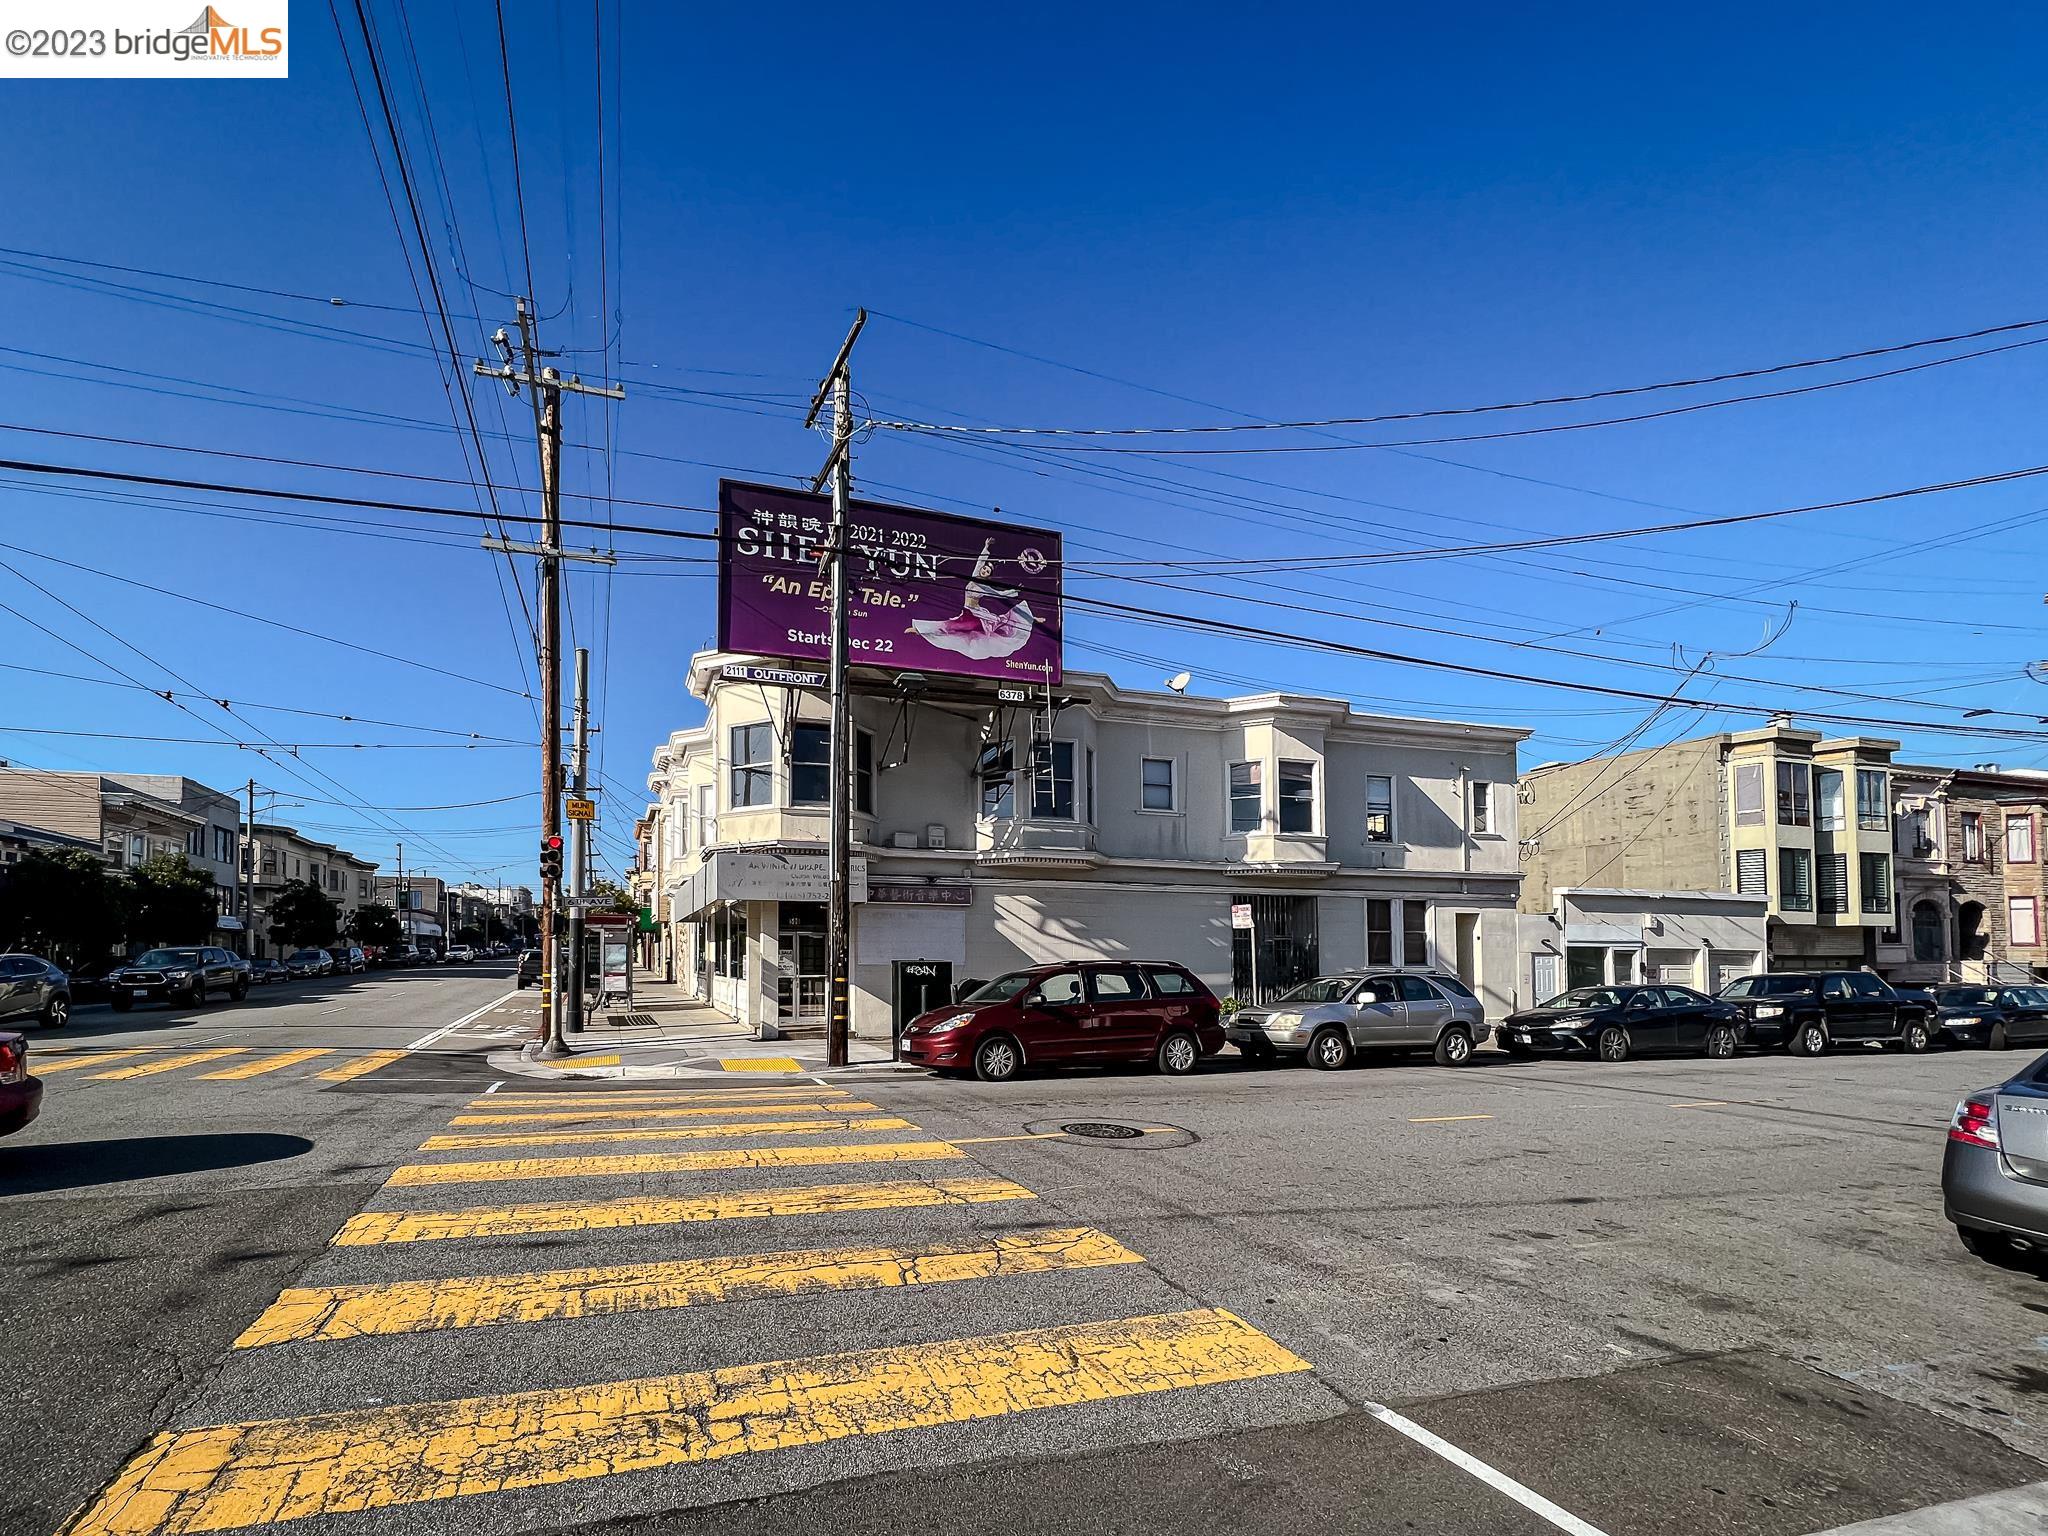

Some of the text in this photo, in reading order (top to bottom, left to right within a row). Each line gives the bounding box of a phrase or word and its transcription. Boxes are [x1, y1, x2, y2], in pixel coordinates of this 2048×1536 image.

[752, 508, 834, 534] 神韻晚
[850, 524, 927, 549] 2021-2022
[737, 527, 937, 580] SHE YUN
[808, 581, 853, 602] Ep
[874, 639, 893, 652] 22
[726, 665, 745, 676] 2111
[754, 669, 818, 684] OUTFRONT
[1000, 691, 1023, 700] 6378
[568, 809, 593, 817] SIGNAL
